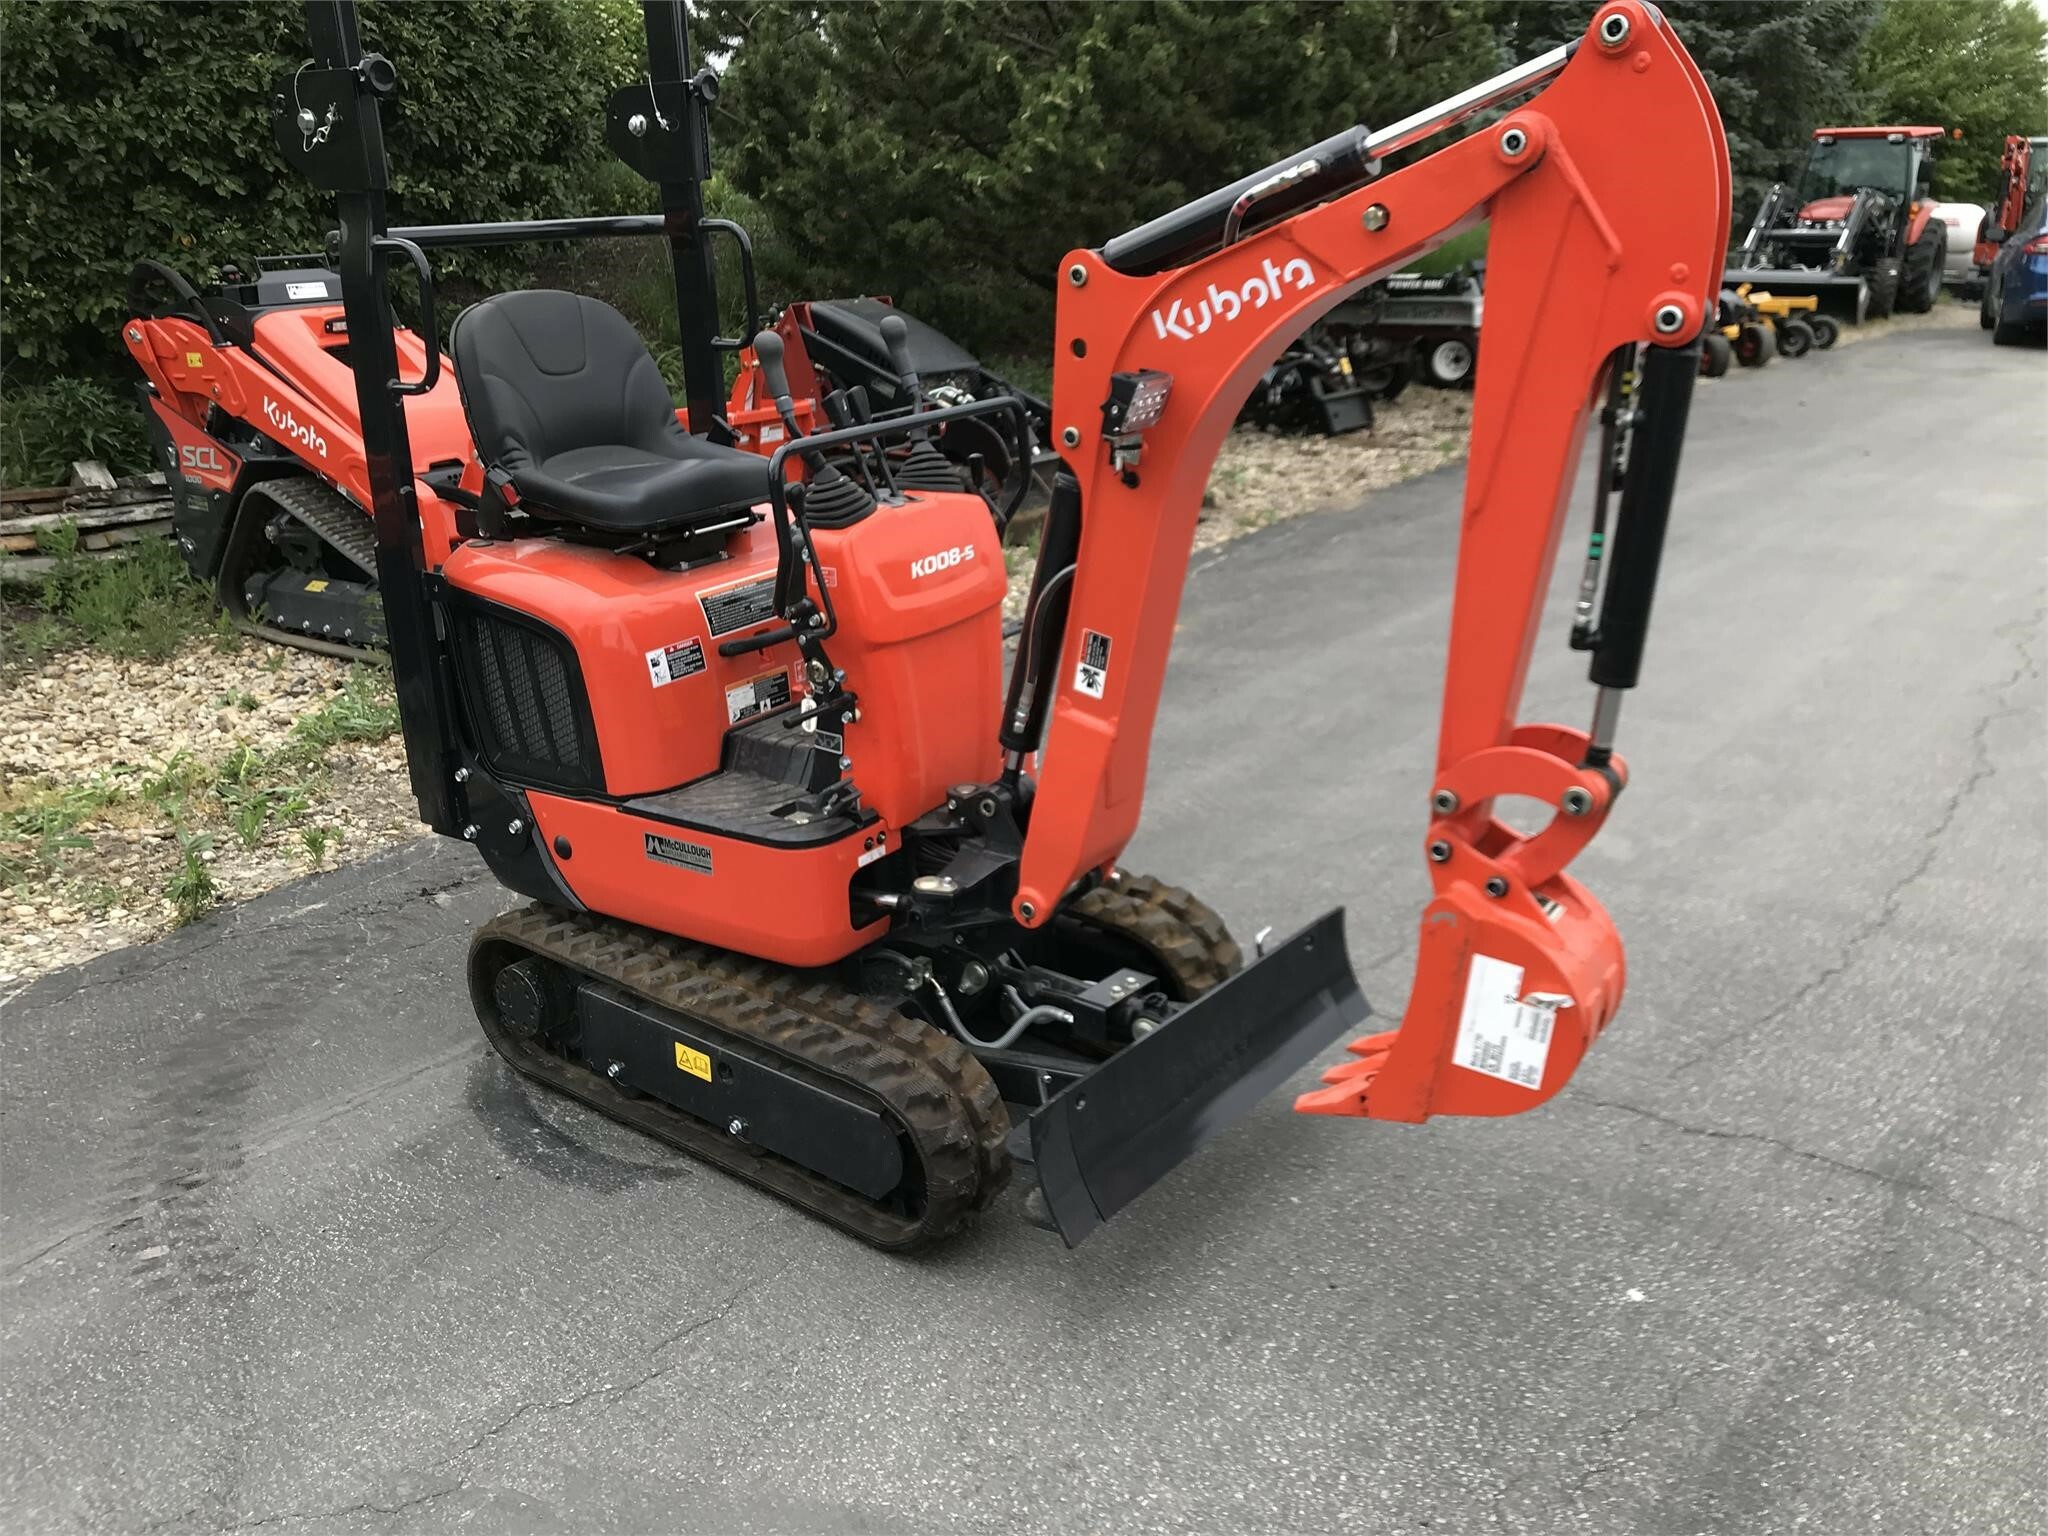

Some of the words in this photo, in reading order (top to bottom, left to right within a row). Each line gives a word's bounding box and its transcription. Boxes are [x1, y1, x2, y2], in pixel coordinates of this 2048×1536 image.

[1152, 258, 1316, 340] Kubota
[182, 445, 223, 470] SCL
[263, 395, 327, 458] Kubota
